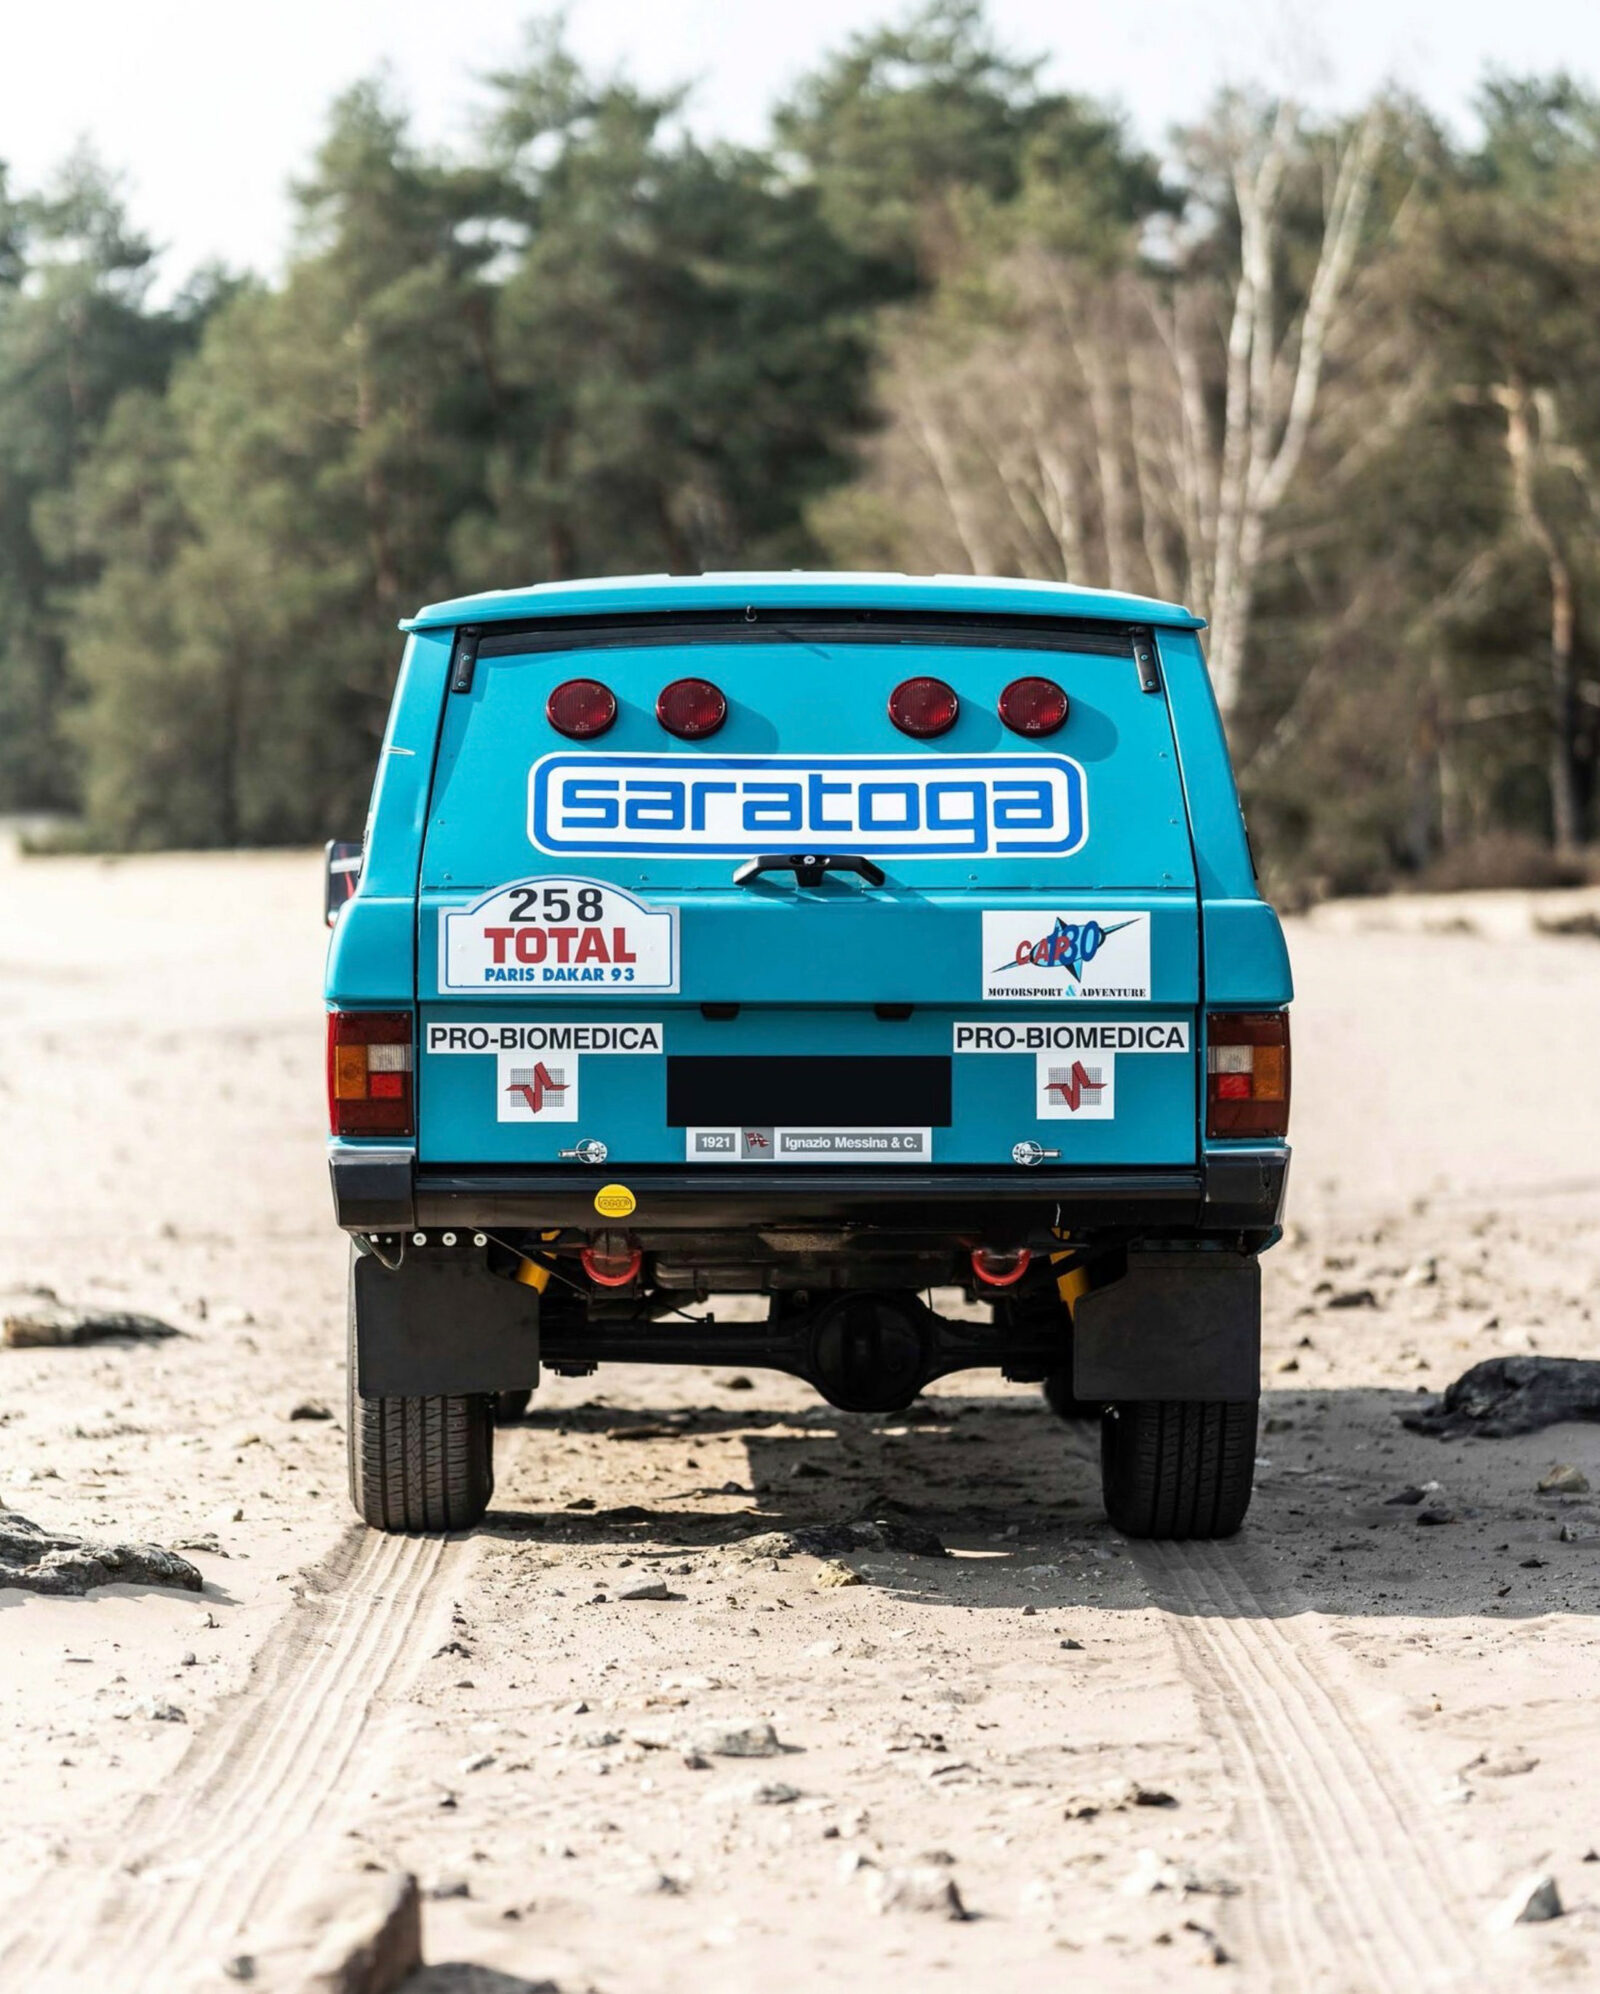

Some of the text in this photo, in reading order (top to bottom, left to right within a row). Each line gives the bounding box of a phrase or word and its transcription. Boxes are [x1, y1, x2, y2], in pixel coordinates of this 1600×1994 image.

[561, 773, 1054, 853] saratoga
[508, 888, 604, 923] 258
[484, 927, 637, 964] TOTAL
[1016, 935, 1070, 966] CAP
[484, 967, 635, 982] PARIS DAKAR 93
[987, 984, 1146, 998] MOTORSPORT & ADVENTURE
[430, 1027, 659, 1050] PRO-BIOMEDICA
[956, 1026, 1185, 1049] PRO-BIOMEDICA
[701, 1136, 918, 1151] 1921 Ignazio Messina & C.
